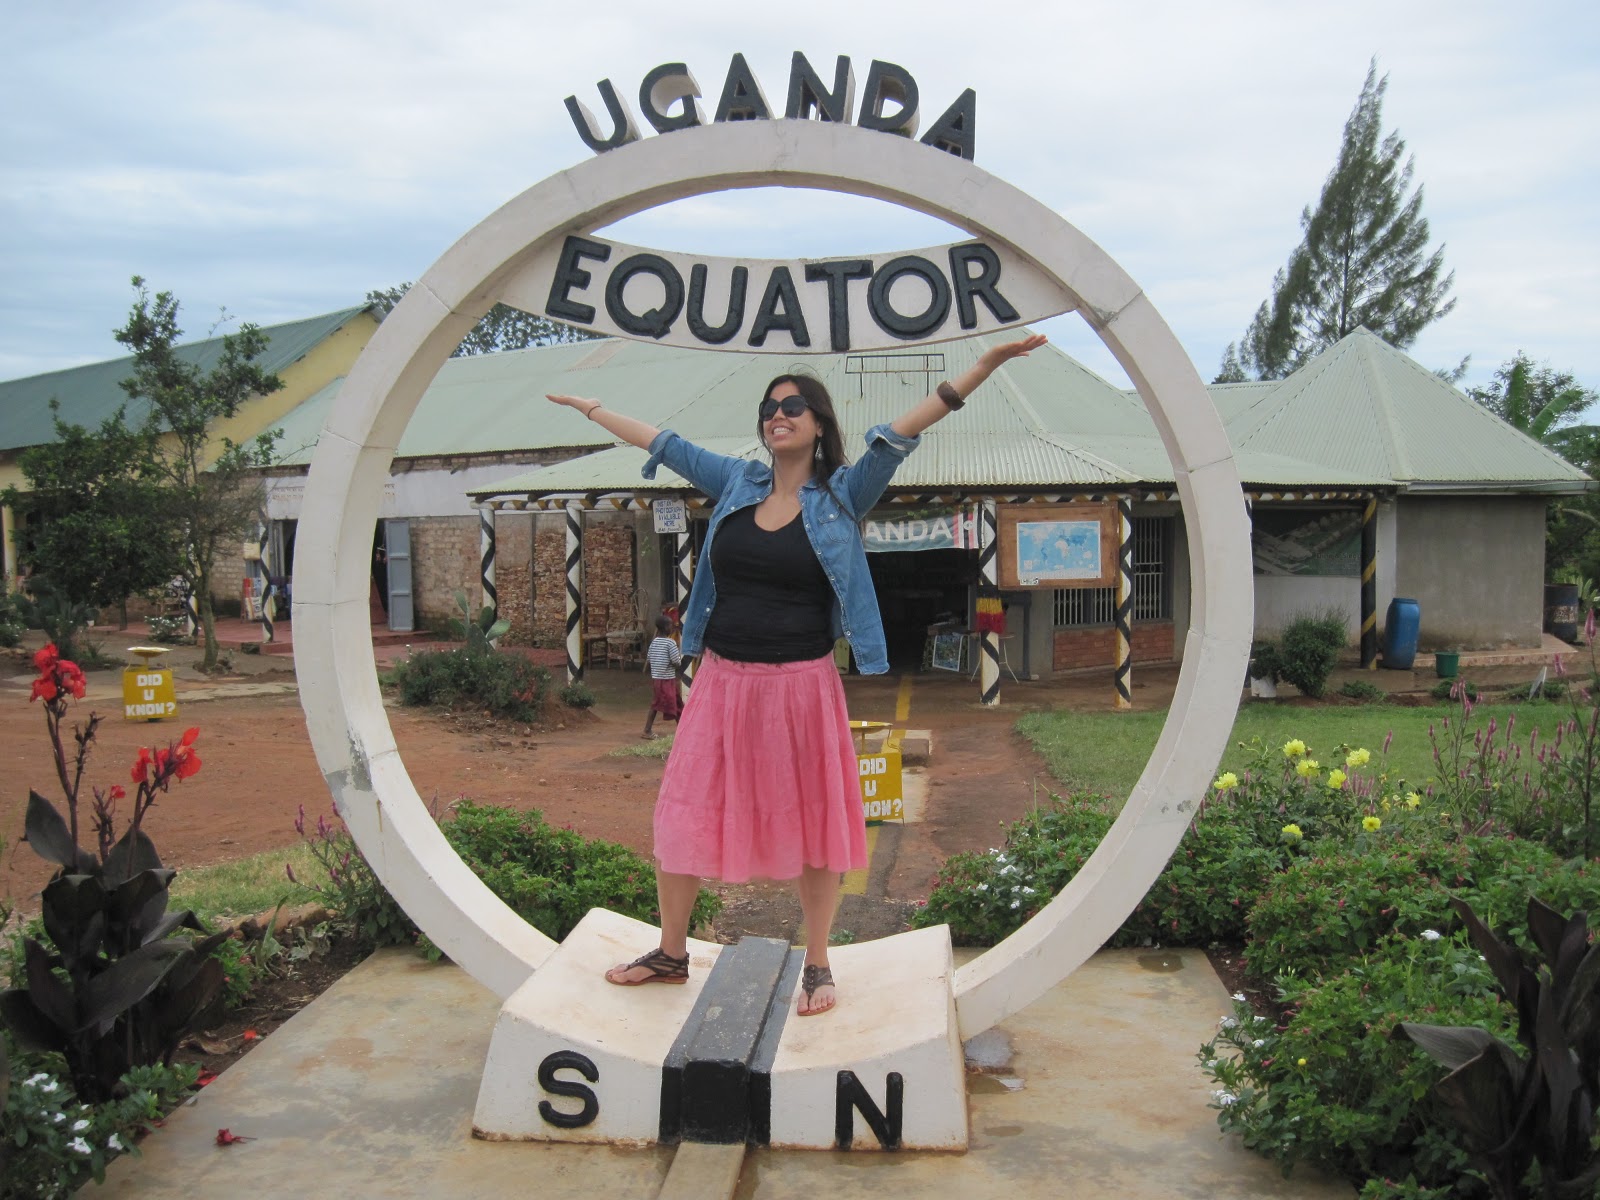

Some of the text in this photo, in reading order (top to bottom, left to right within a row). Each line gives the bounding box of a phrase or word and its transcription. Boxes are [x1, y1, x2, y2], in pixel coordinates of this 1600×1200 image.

[564, 51, 977, 162] UGANDA
[545, 236, 1021, 352] EQUATOR
[866, 517, 953, 542] ANDA
[137, 674, 163, 687] DID
[144, 689, 154, 701] U
[125, 702, 176, 716] KNOW?
[859, 757, 887, 775] DID
[864, 780, 877, 797] U
[863, 798, 903, 818] NOW?
[538, 1050, 600, 1128] S
[835, 1070, 904, 1151] N
